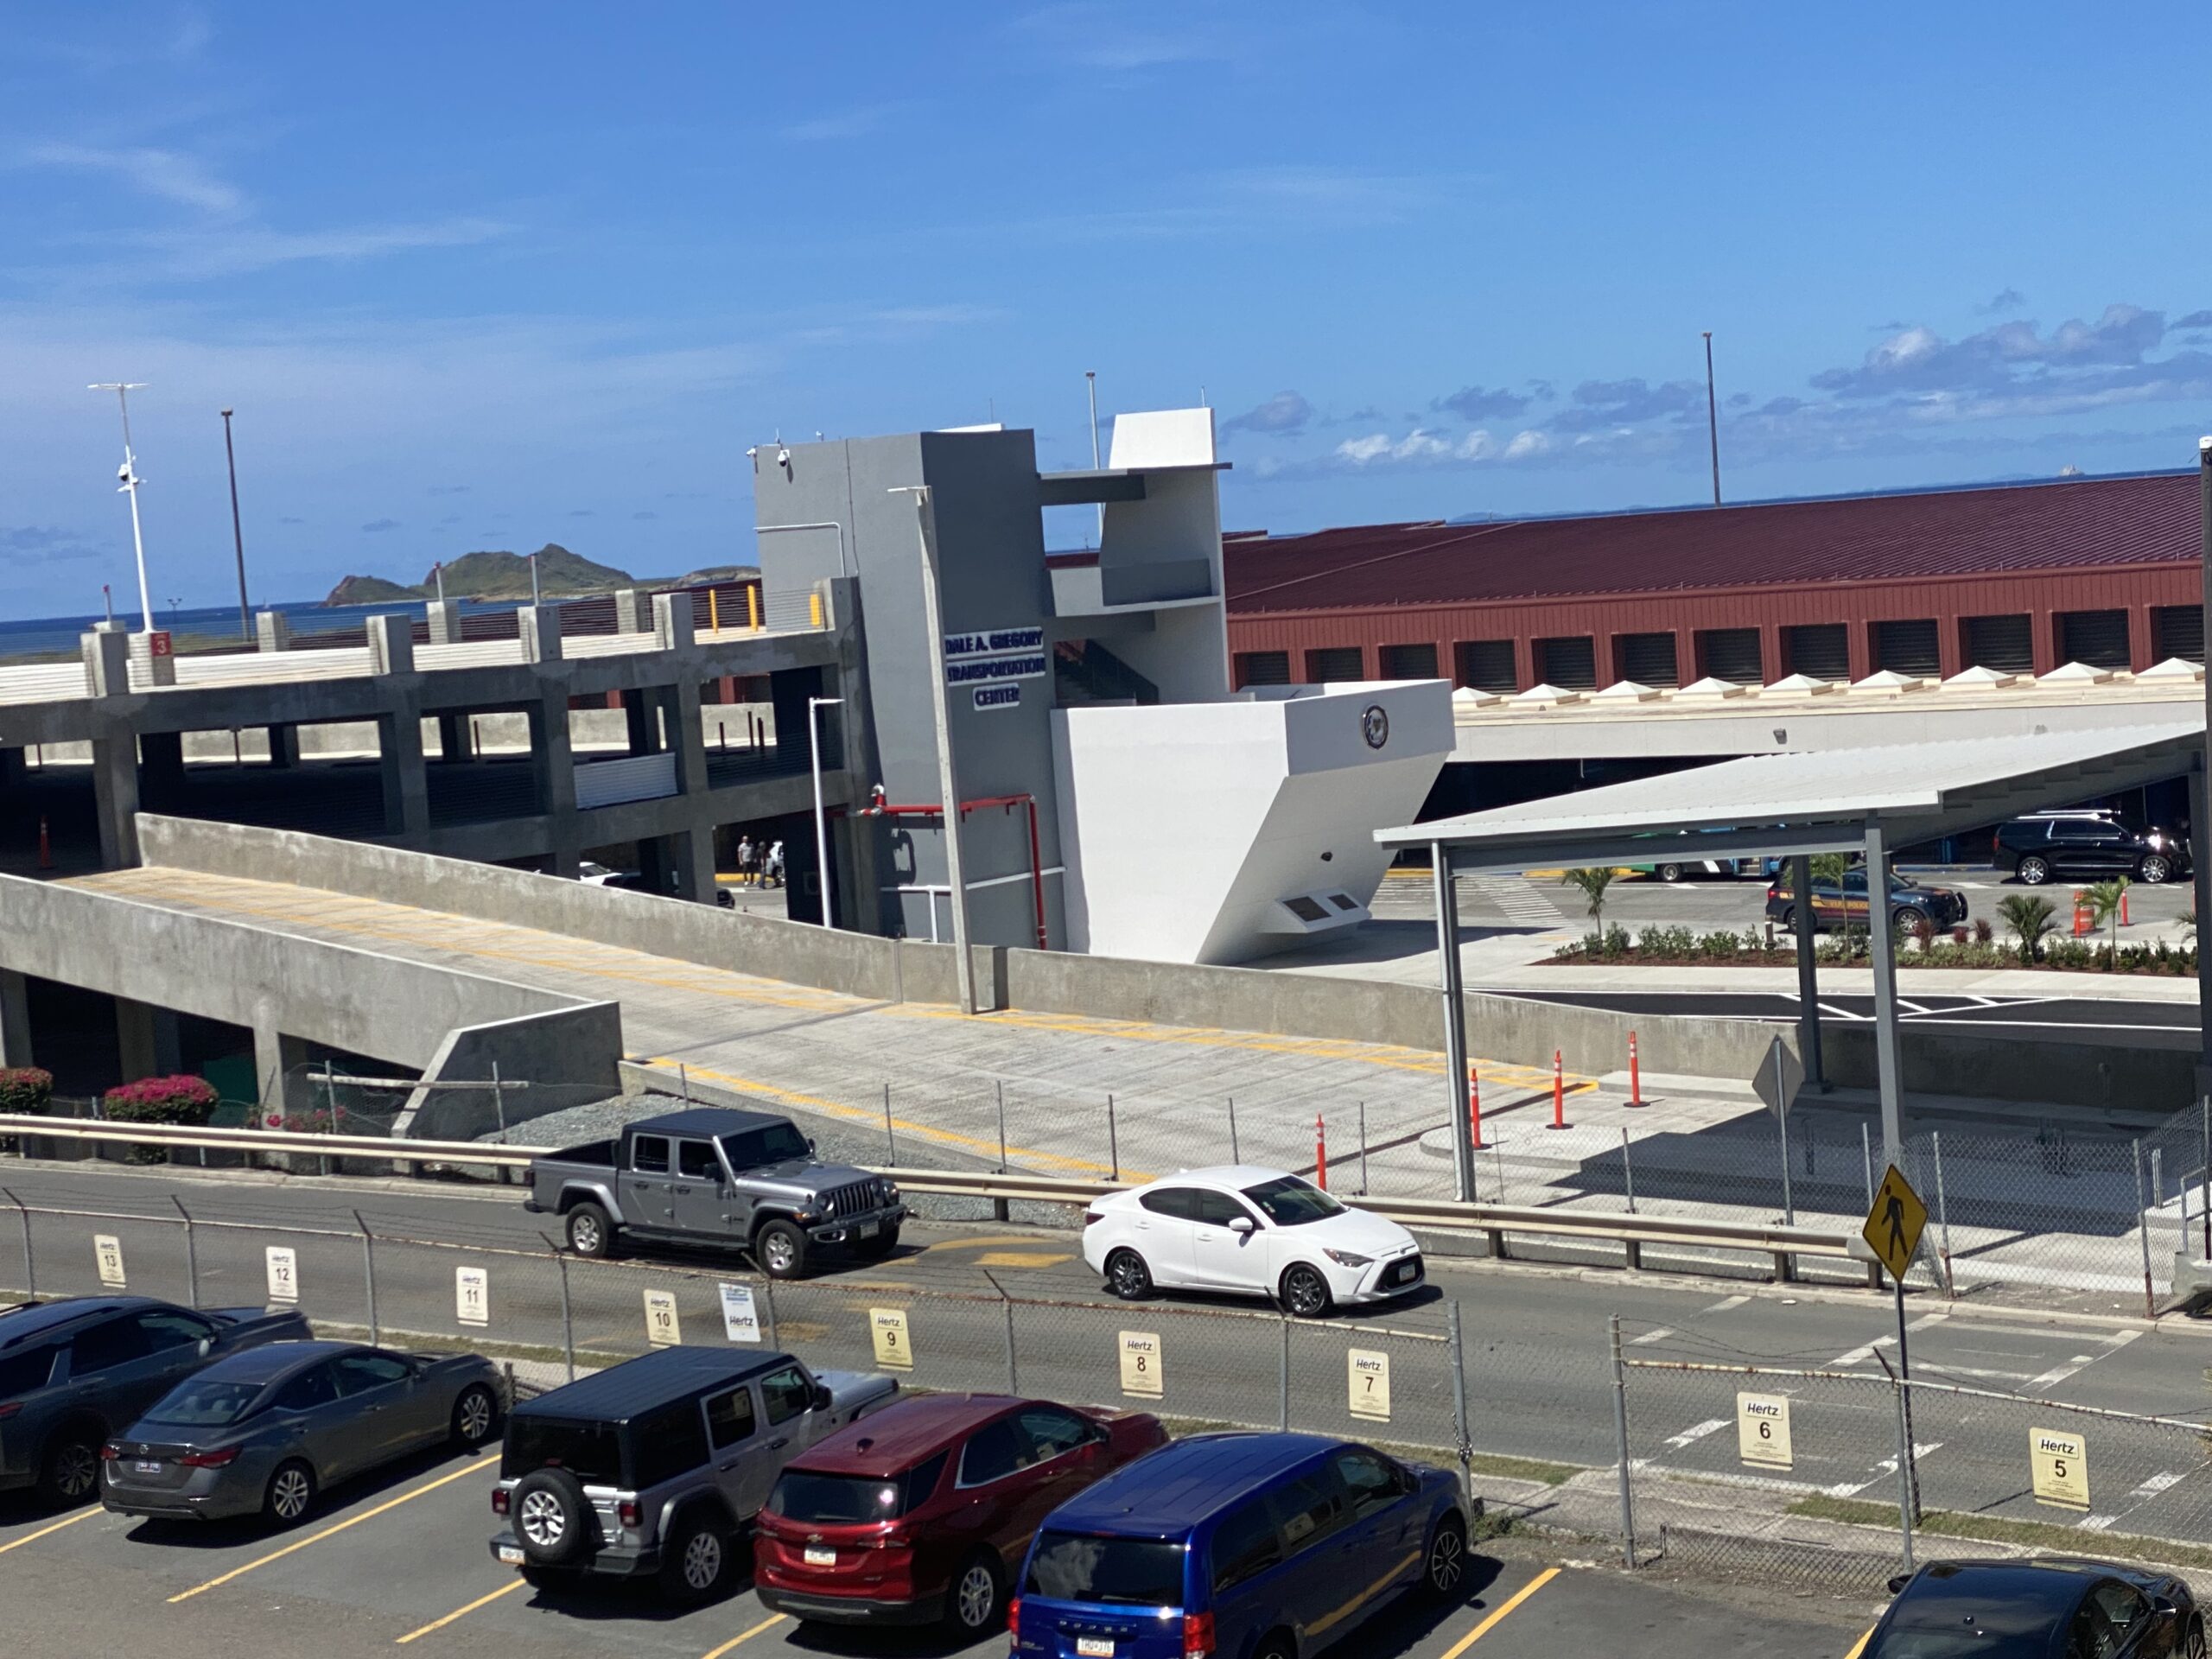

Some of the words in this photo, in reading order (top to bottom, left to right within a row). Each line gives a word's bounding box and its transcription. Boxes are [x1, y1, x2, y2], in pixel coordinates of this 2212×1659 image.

[157, 639, 167, 654] 3
[945, 638, 974, 654] DALE
[975, 636, 988, 652] A.
[989, 630, 1043, 650] GREGORY
[947, 657, 1046, 683] TRANSPORTATION
[975, 687, 1020, 707] CENTER
[105, 1255, 117, 1267] 13
[276, 1268, 289, 1281] 12
[467, 1289, 478, 1303] 11
[651, 1298, 671, 1308] Hertz
[656, 1312, 671, 1326] 10
[729, 1315, 753, 1327] Hertz
[878, 1317, 900, 1327] Hertz
[887, 1332, 896, 1346] 9
[1127, 1340, 1154, 1351] Hertz
[1137, 1356, 1147, 1372] 8
[1356, 1357, 1382, 1371] Hertz
[1365, 1376, 1374, 1393] 7
[1747, 1402, 1779, 1416] Hertz
[1759, 1421, 1771, 1440] 6
[2040, 1439, 2075, 1455] Hertz
[2055, 1459, 2067, 1478] 5
